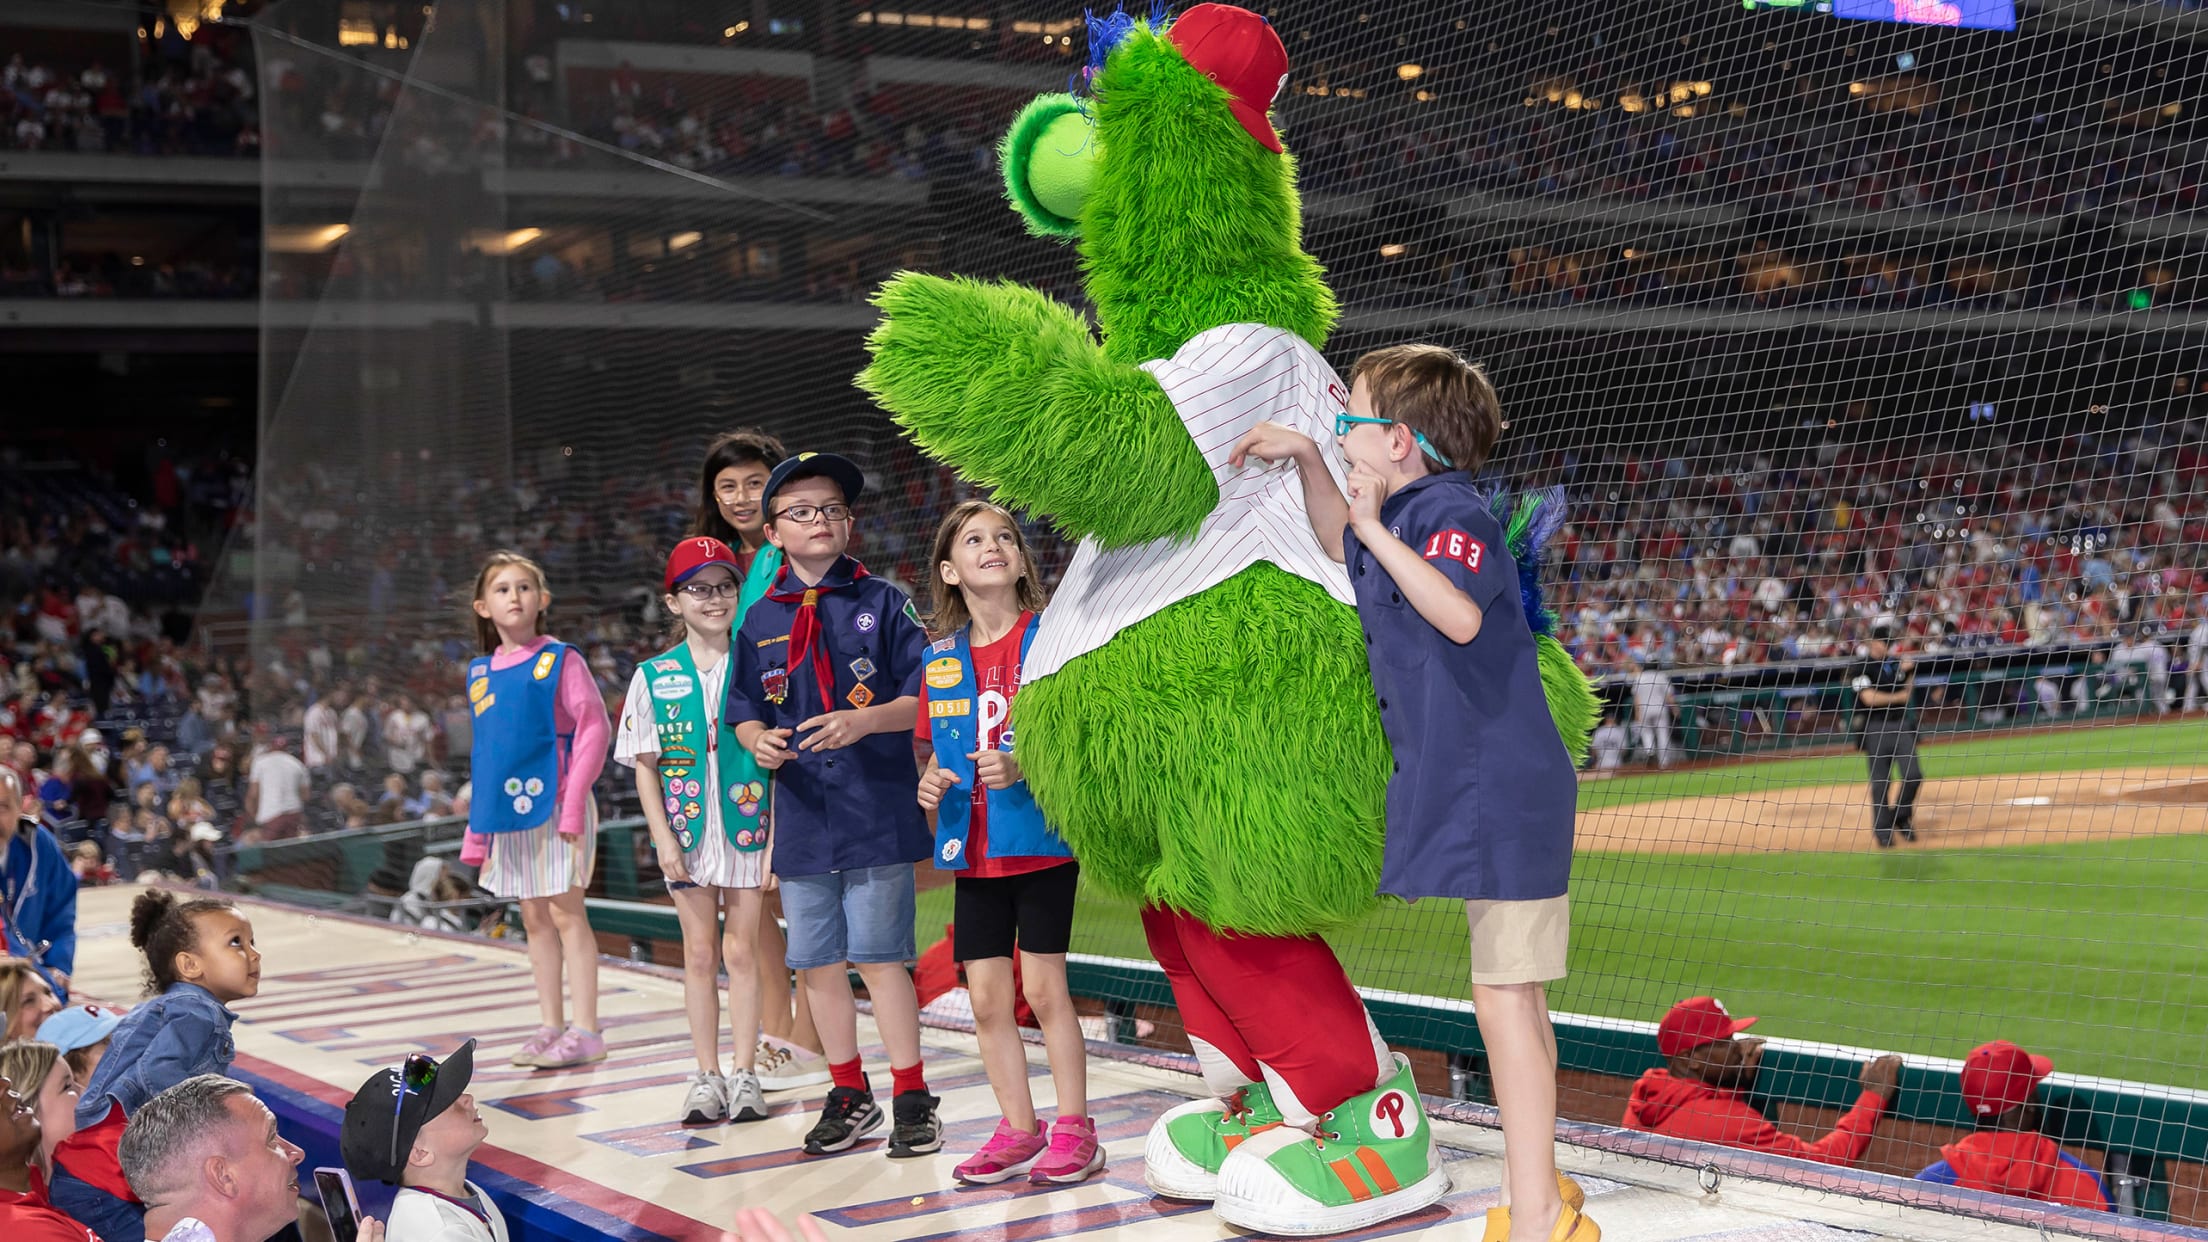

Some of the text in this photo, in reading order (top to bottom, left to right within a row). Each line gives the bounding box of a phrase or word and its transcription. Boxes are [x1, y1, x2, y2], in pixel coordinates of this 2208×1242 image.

[1426, 533, 1481, 568] 163
[657, 721, 693, 734] 9674
[977, 690, 1009, 752] P
[84, 1005, 100, 1019] P
[1376, 1092, 1405, 1138] P
